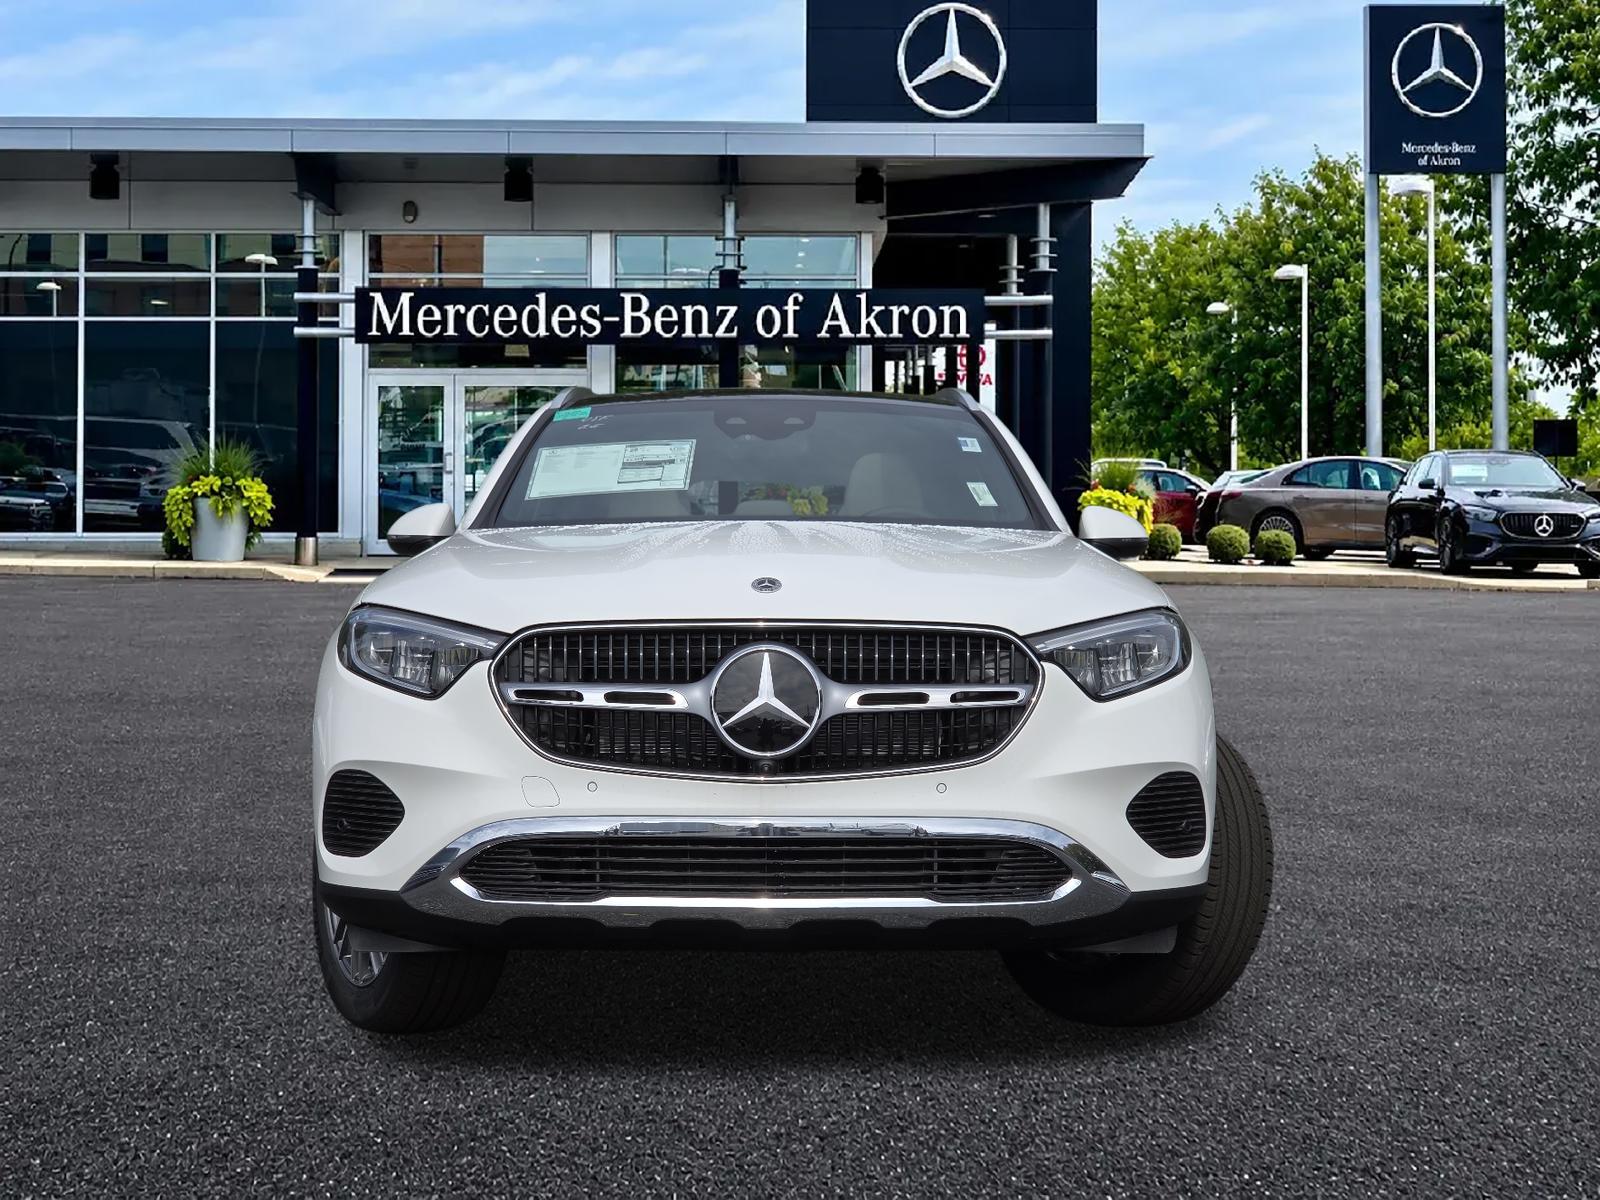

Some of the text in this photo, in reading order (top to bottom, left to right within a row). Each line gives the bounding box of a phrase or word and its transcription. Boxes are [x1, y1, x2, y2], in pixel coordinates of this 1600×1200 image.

[1401, 141, 1476, 154] Mercedes-Benz
[1417, 154, 1461, 166] of Akron
[367, 292, 970, 338] Mercedes-Benz of Akron
